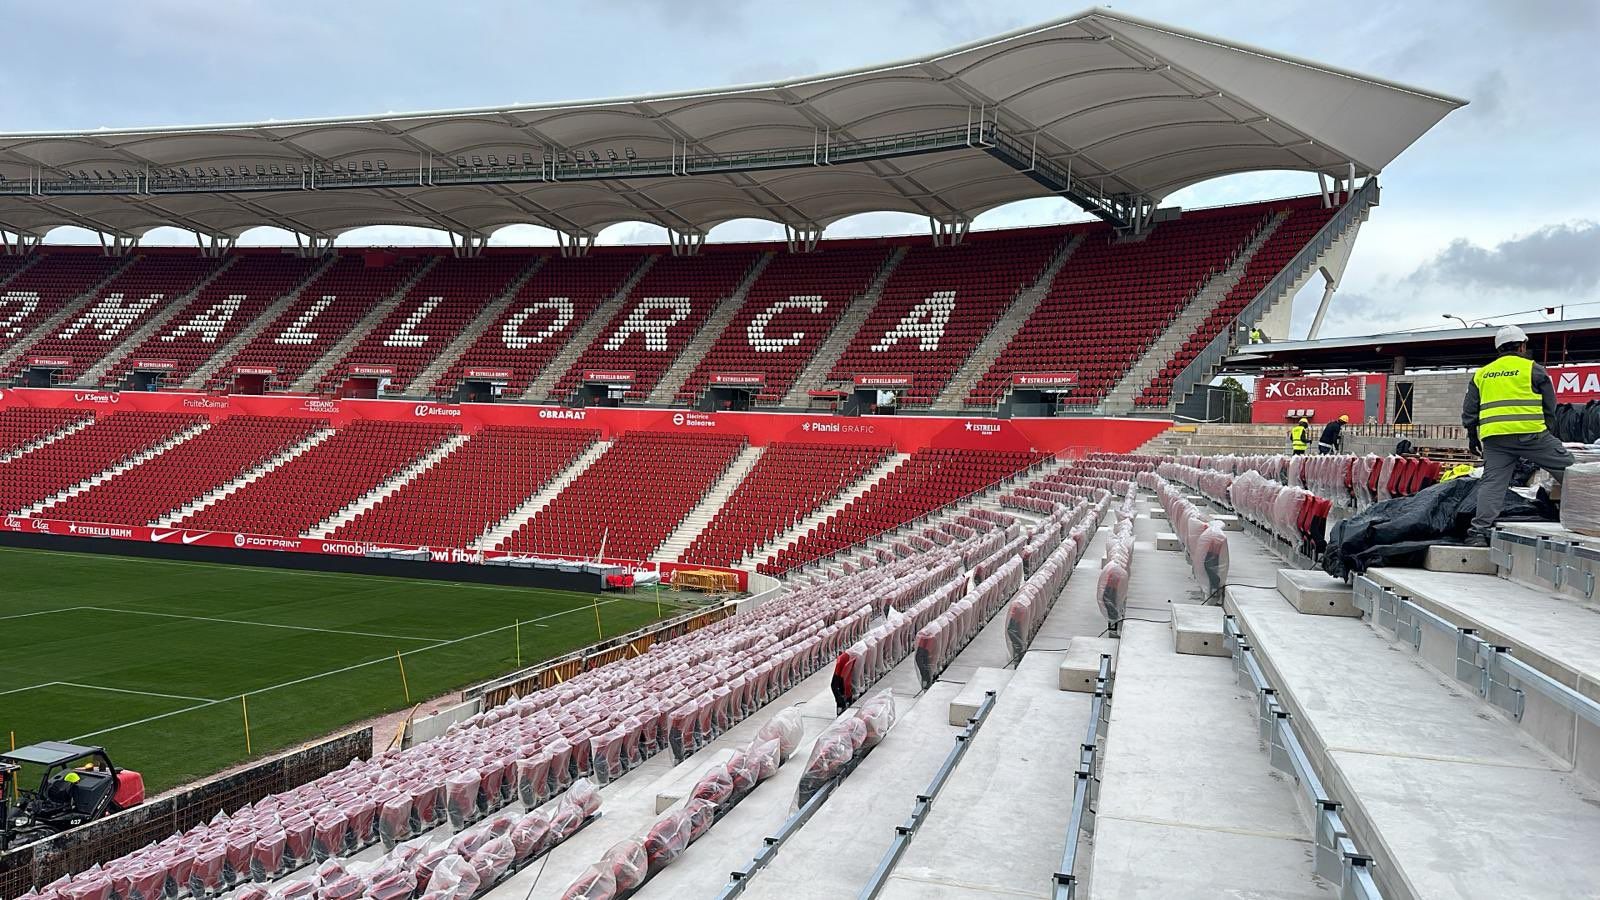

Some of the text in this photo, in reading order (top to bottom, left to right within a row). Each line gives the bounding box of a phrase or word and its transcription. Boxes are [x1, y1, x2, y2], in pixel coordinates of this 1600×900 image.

[59, 290, 956, 352] MALLORCA
[1483, 369, 1520, 379] daplast
[1549, 372, 1600, 393] MA
[1283, 381, 1352, 397] CaixaBank
[539, 410, 586, 419] OBRAMAT
[812, 422, 840, 432] Planisi
[973, 424, 1001, 432] ESTRELLA
[78, 526, 132, 538] ESTRELLA DAMM
[246, 537, 301, 548] FOOTPRINT
